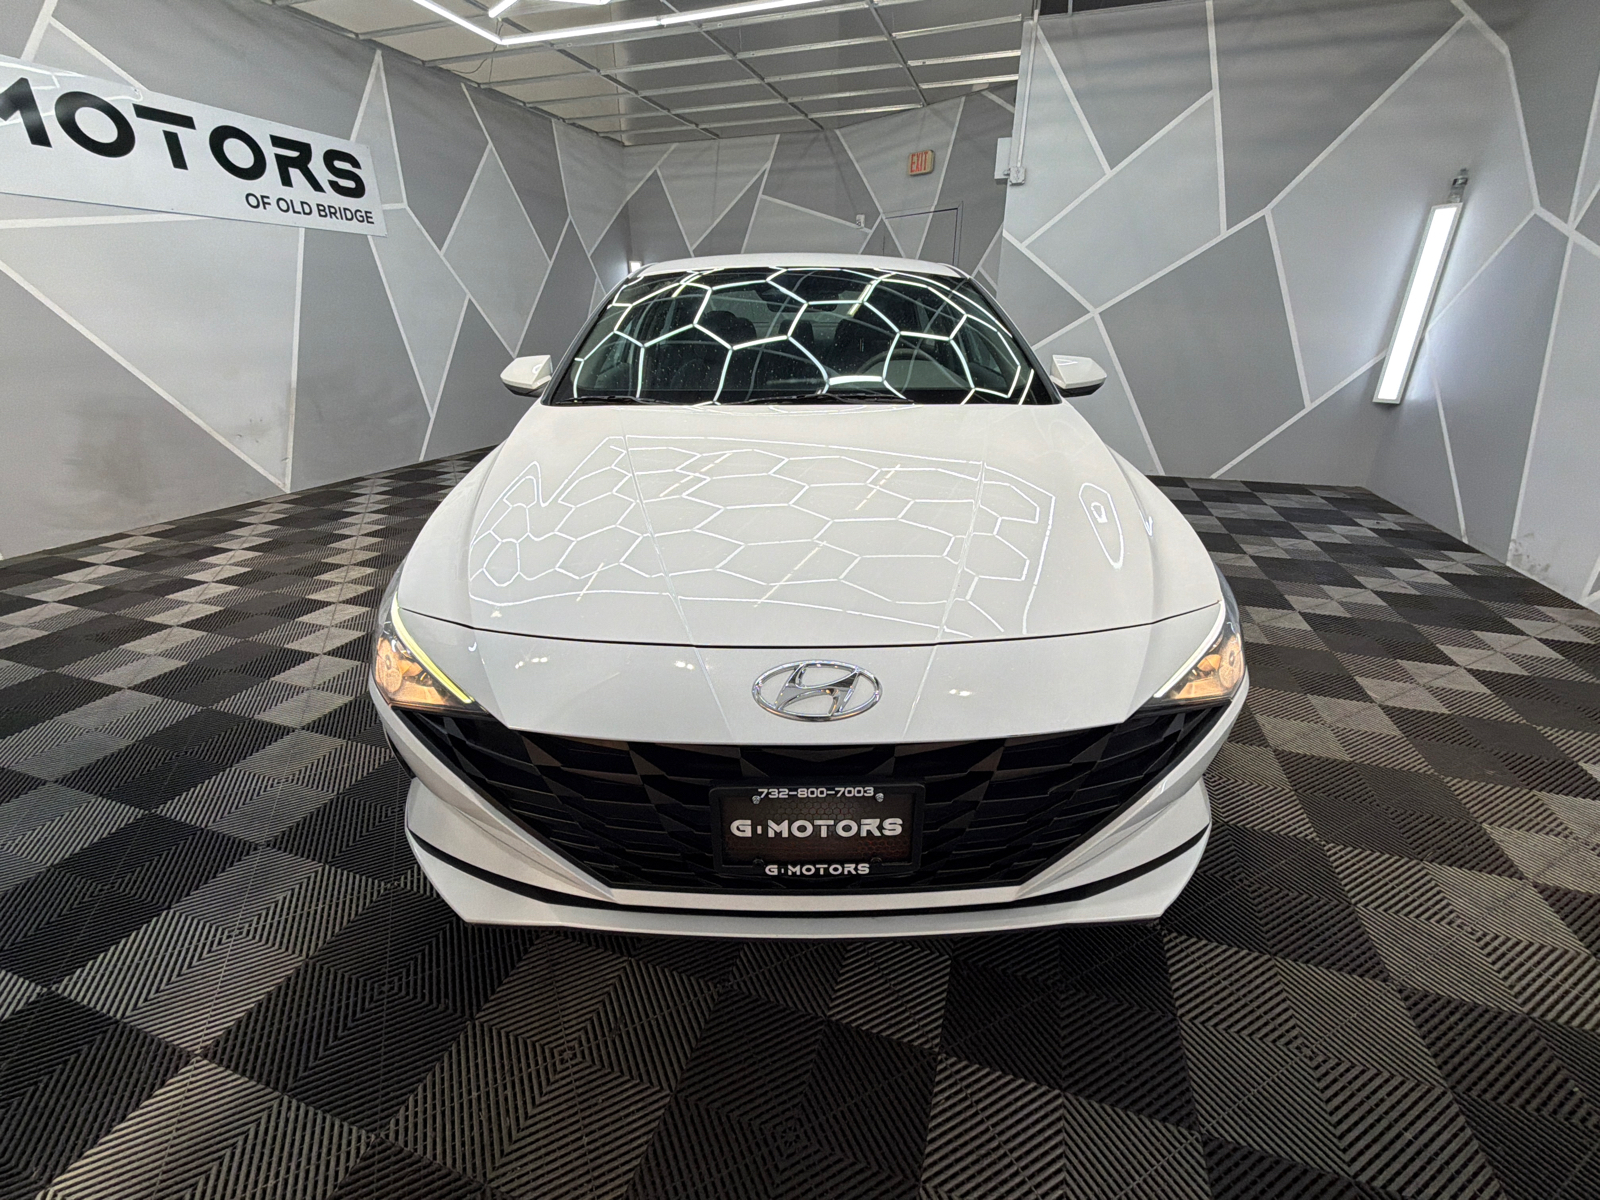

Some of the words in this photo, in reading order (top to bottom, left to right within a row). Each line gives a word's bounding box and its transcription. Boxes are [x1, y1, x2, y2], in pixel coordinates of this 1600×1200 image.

[911, 151, 928, 172] EXIT
[245, 193, 271, 210] OF
[276, 197, 313, 216] OLD
[316, 203, 375, 225] BRIDGE
[757, 786, 874, 798] 732-800-7003
